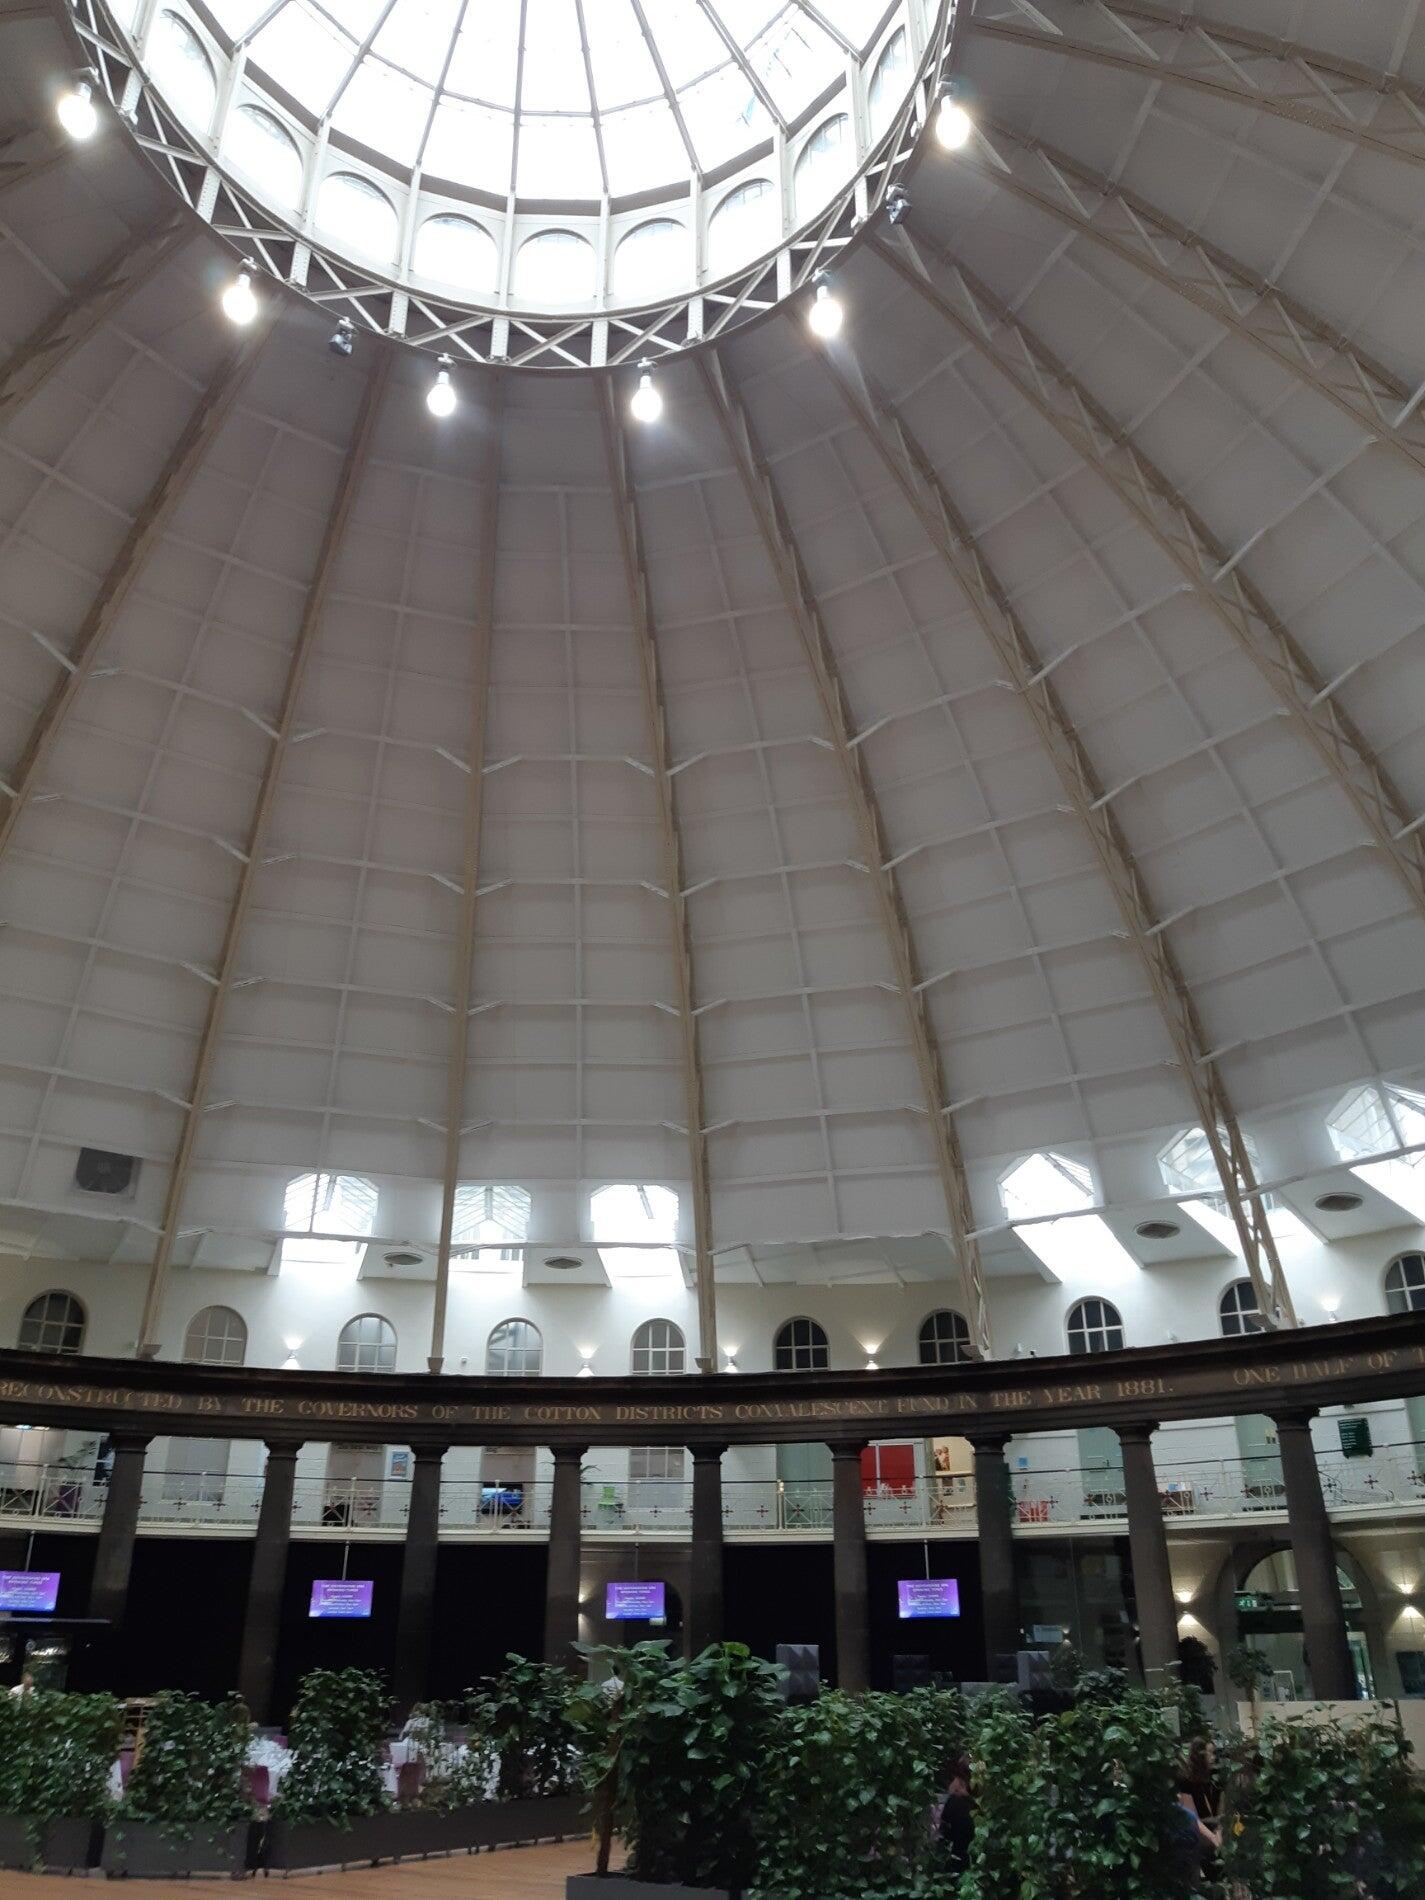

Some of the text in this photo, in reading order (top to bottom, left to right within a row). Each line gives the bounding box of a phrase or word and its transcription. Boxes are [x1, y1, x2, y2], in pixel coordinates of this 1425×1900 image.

[1233, 1366, 1281, 1386] ONE
[1292, 1357, 1354, 1379] HALF
[1368, 1351, 1397, 1370] OF
[241, 1398, 284, 1414] THE
[432, 1405, 459, 1419] OF
[472, 1406, 511, 1420] THE
[524, 1406, 601, 1420] COTTON
[616, 1406, 723, 1420] DISTRICTS
[735, 1399, 889, 1418] CONVALESCENT
[896, 1396, 950, 1413] FUND
[959, 1392, 978, 1409] IN
[990, 1391, 1031, 1407] THE
[1043, 1384, 1101, 1403] YEAR
[1117, 1378, 1173, 1397] 1881.
